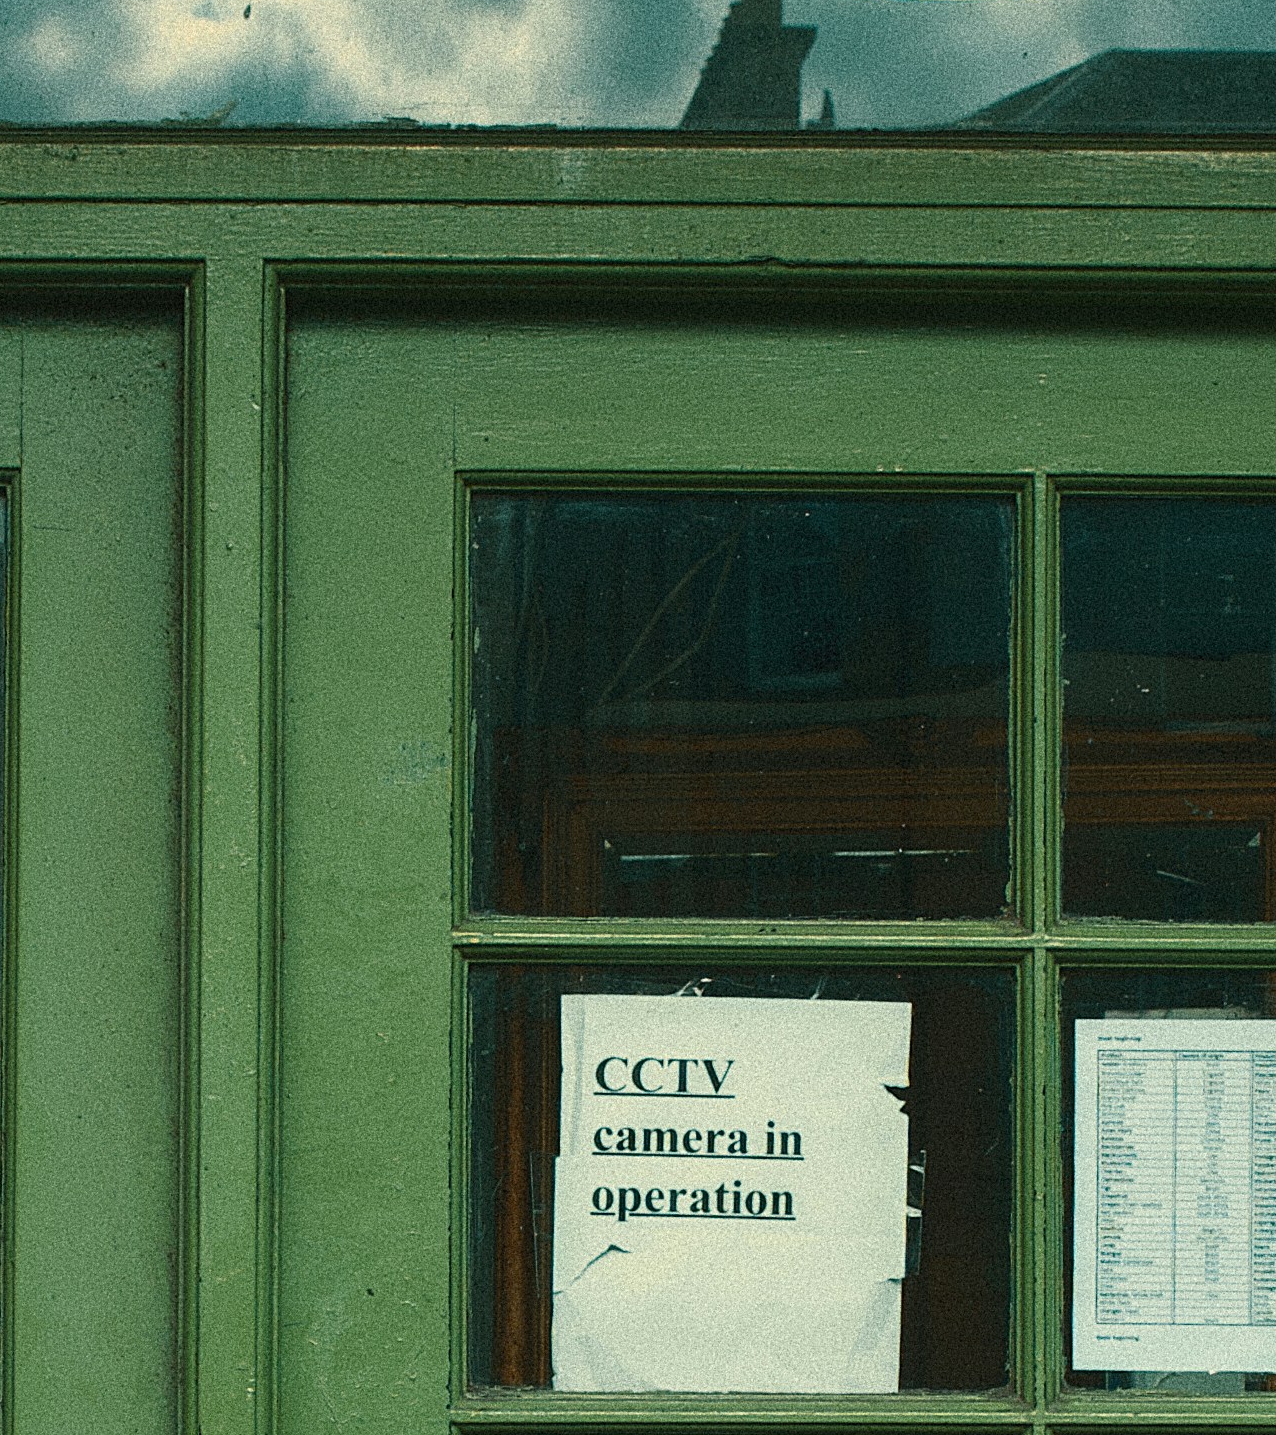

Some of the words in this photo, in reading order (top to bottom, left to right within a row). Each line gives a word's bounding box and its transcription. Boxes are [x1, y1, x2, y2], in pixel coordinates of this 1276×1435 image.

[594, 1055, 735, 1097] CCTV
[592, 1125, 748, 1158] camera
[766, 1120, 804, 1160] in
[591, 1179, 795, 1222] operation
